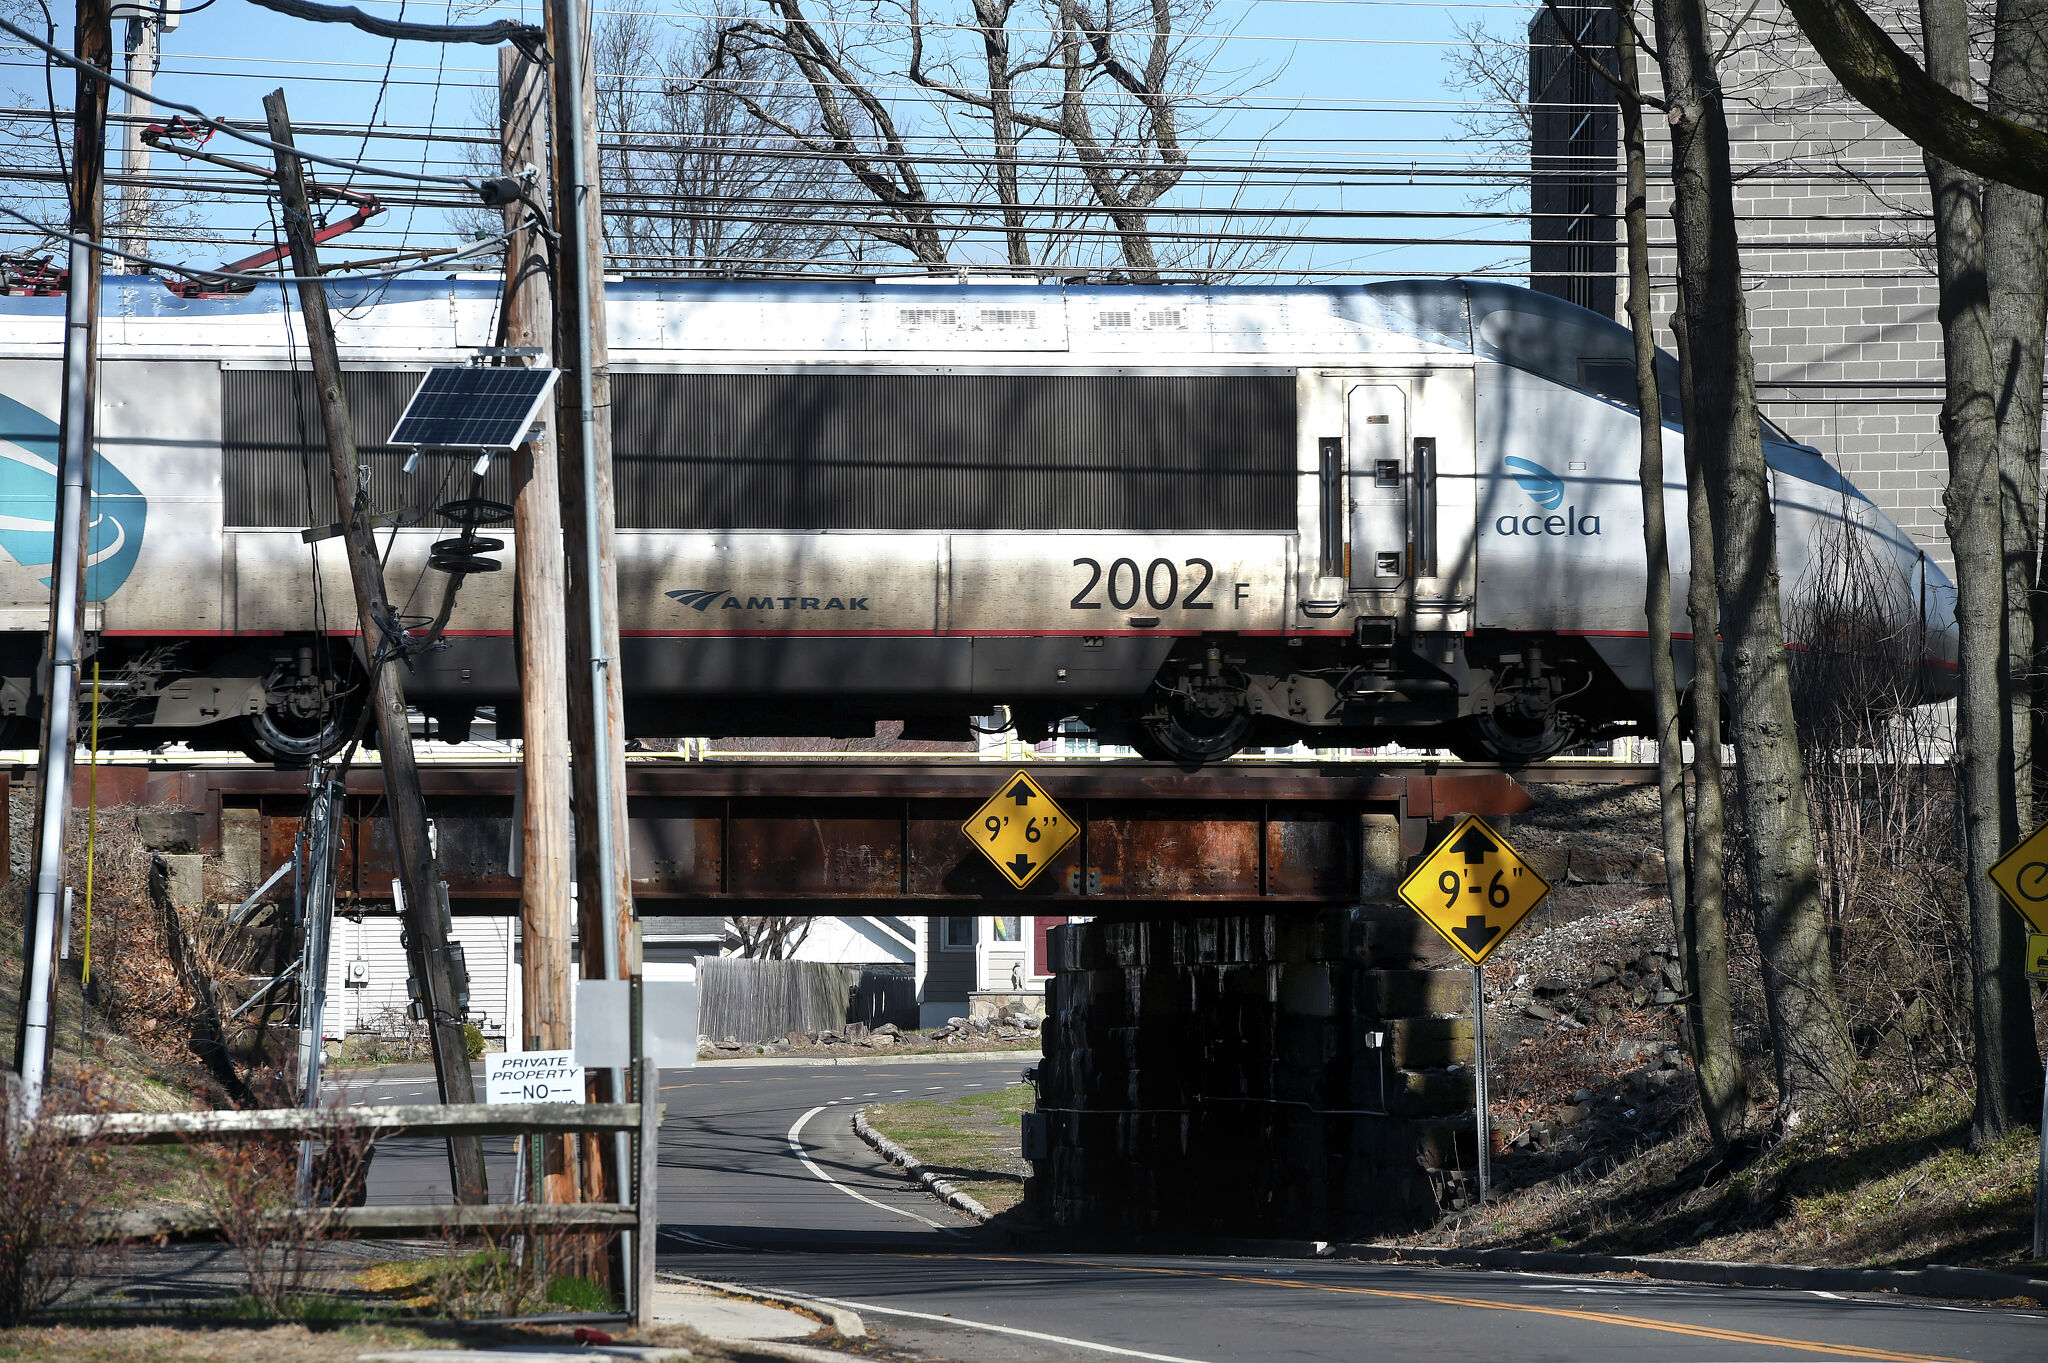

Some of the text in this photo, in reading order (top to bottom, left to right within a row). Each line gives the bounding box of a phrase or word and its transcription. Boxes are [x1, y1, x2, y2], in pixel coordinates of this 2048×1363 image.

[1496, 505, 1602, 536] acela
[1070, 557, 1250, 610] 2002 F
[721, 596, 870, 611] AMTRAK
[502, 1056, 569, 1069] PRIVATE
[492, 1068, 578, 1081] PROPERTY
